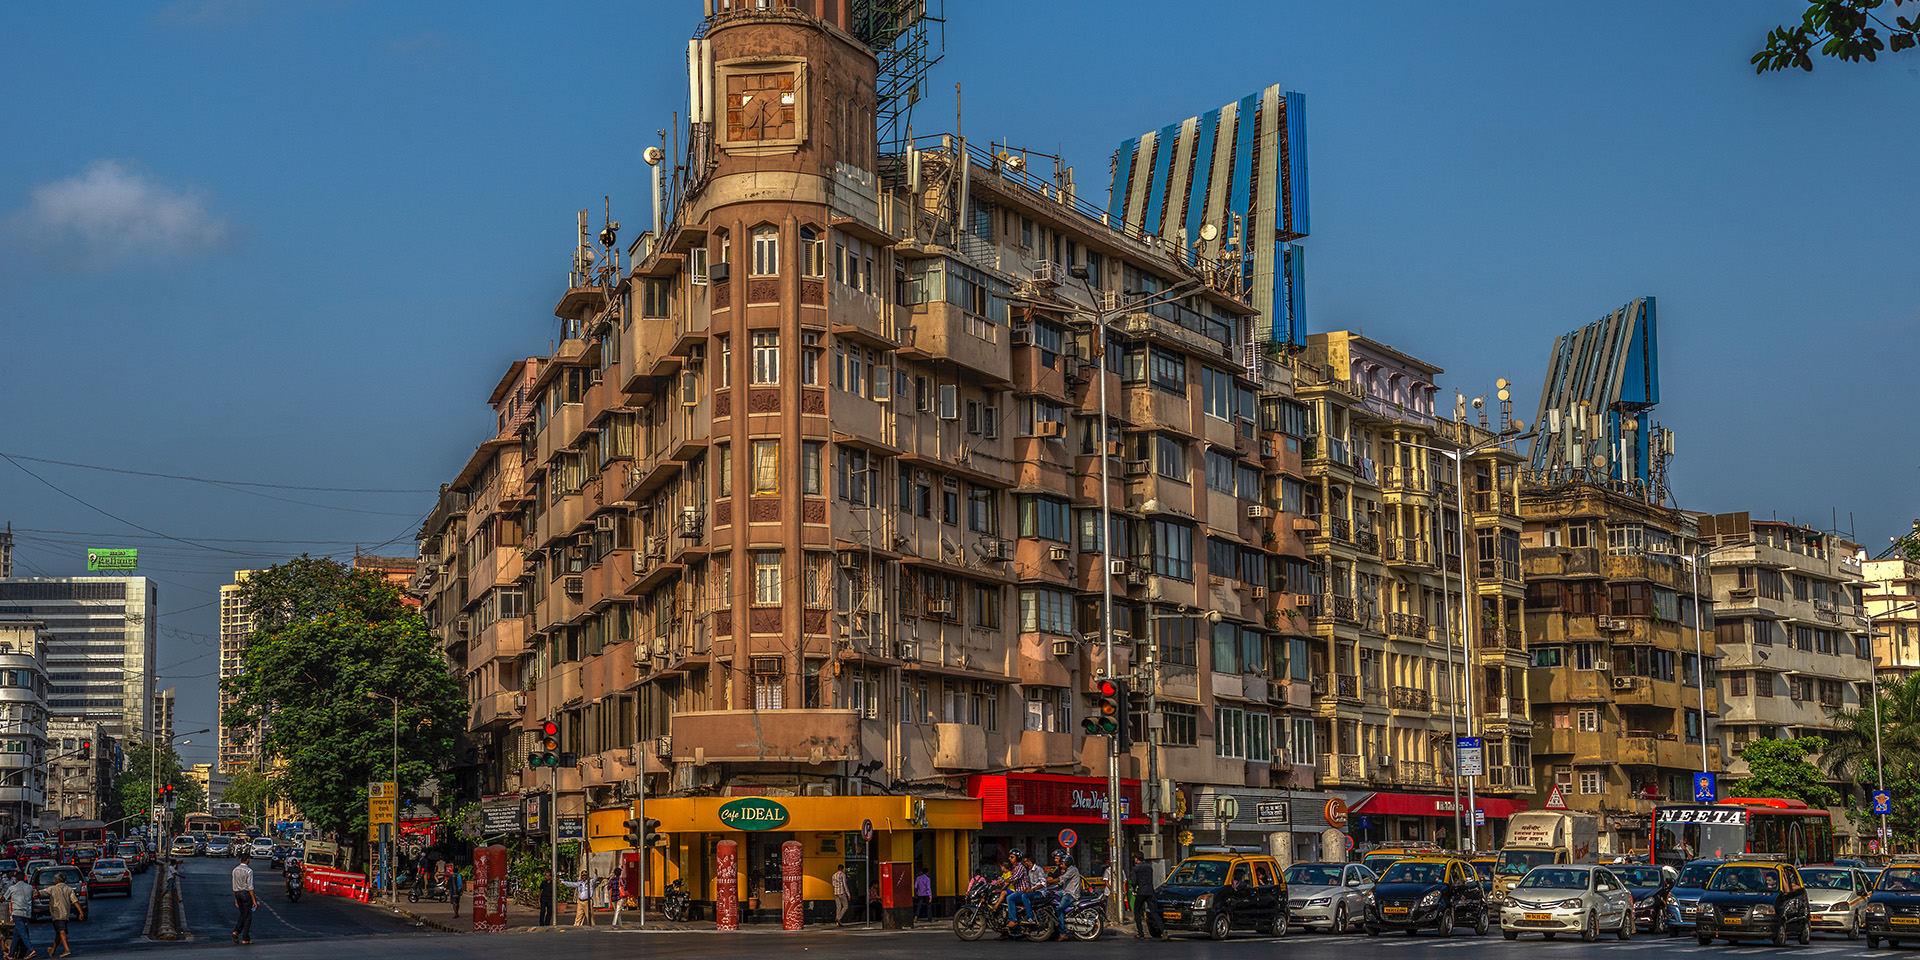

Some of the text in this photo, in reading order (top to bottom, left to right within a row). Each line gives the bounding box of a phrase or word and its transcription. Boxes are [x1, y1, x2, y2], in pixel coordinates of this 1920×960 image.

[98, 556, 137, 565] Reliance
[720, 807, 785, 822] Cafe IDEAL
[1658, 809, 1742, 824] NEETA
